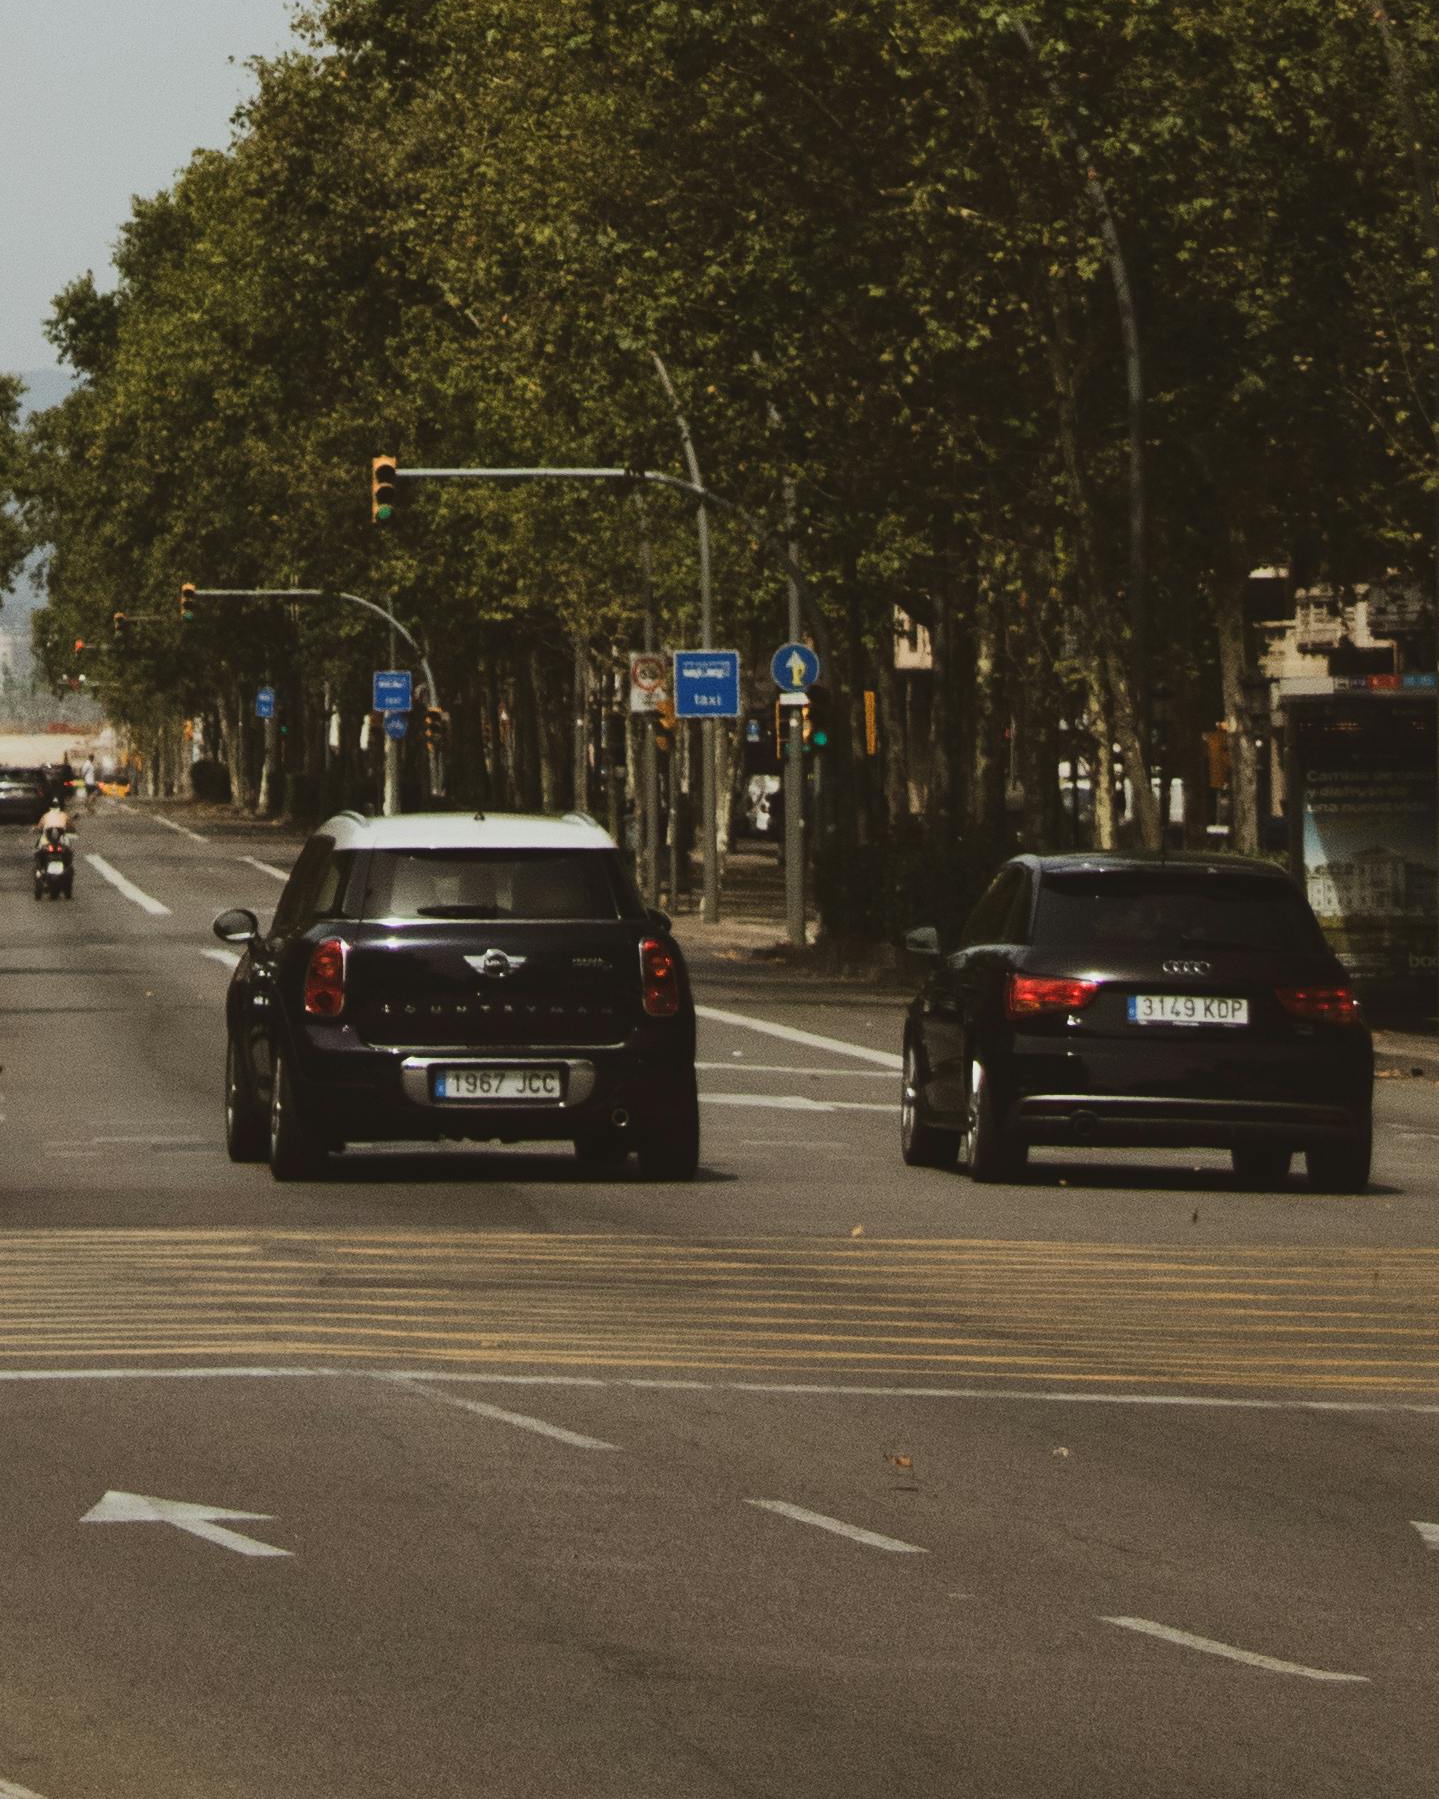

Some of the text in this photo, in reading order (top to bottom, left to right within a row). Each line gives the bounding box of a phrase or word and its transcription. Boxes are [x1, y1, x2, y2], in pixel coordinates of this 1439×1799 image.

[694, 694, 722, 706] taxi
[1143, 997, 1243, 1019] 3149 KDP
[454, 1071, 556, 1094] 1967 JCC
